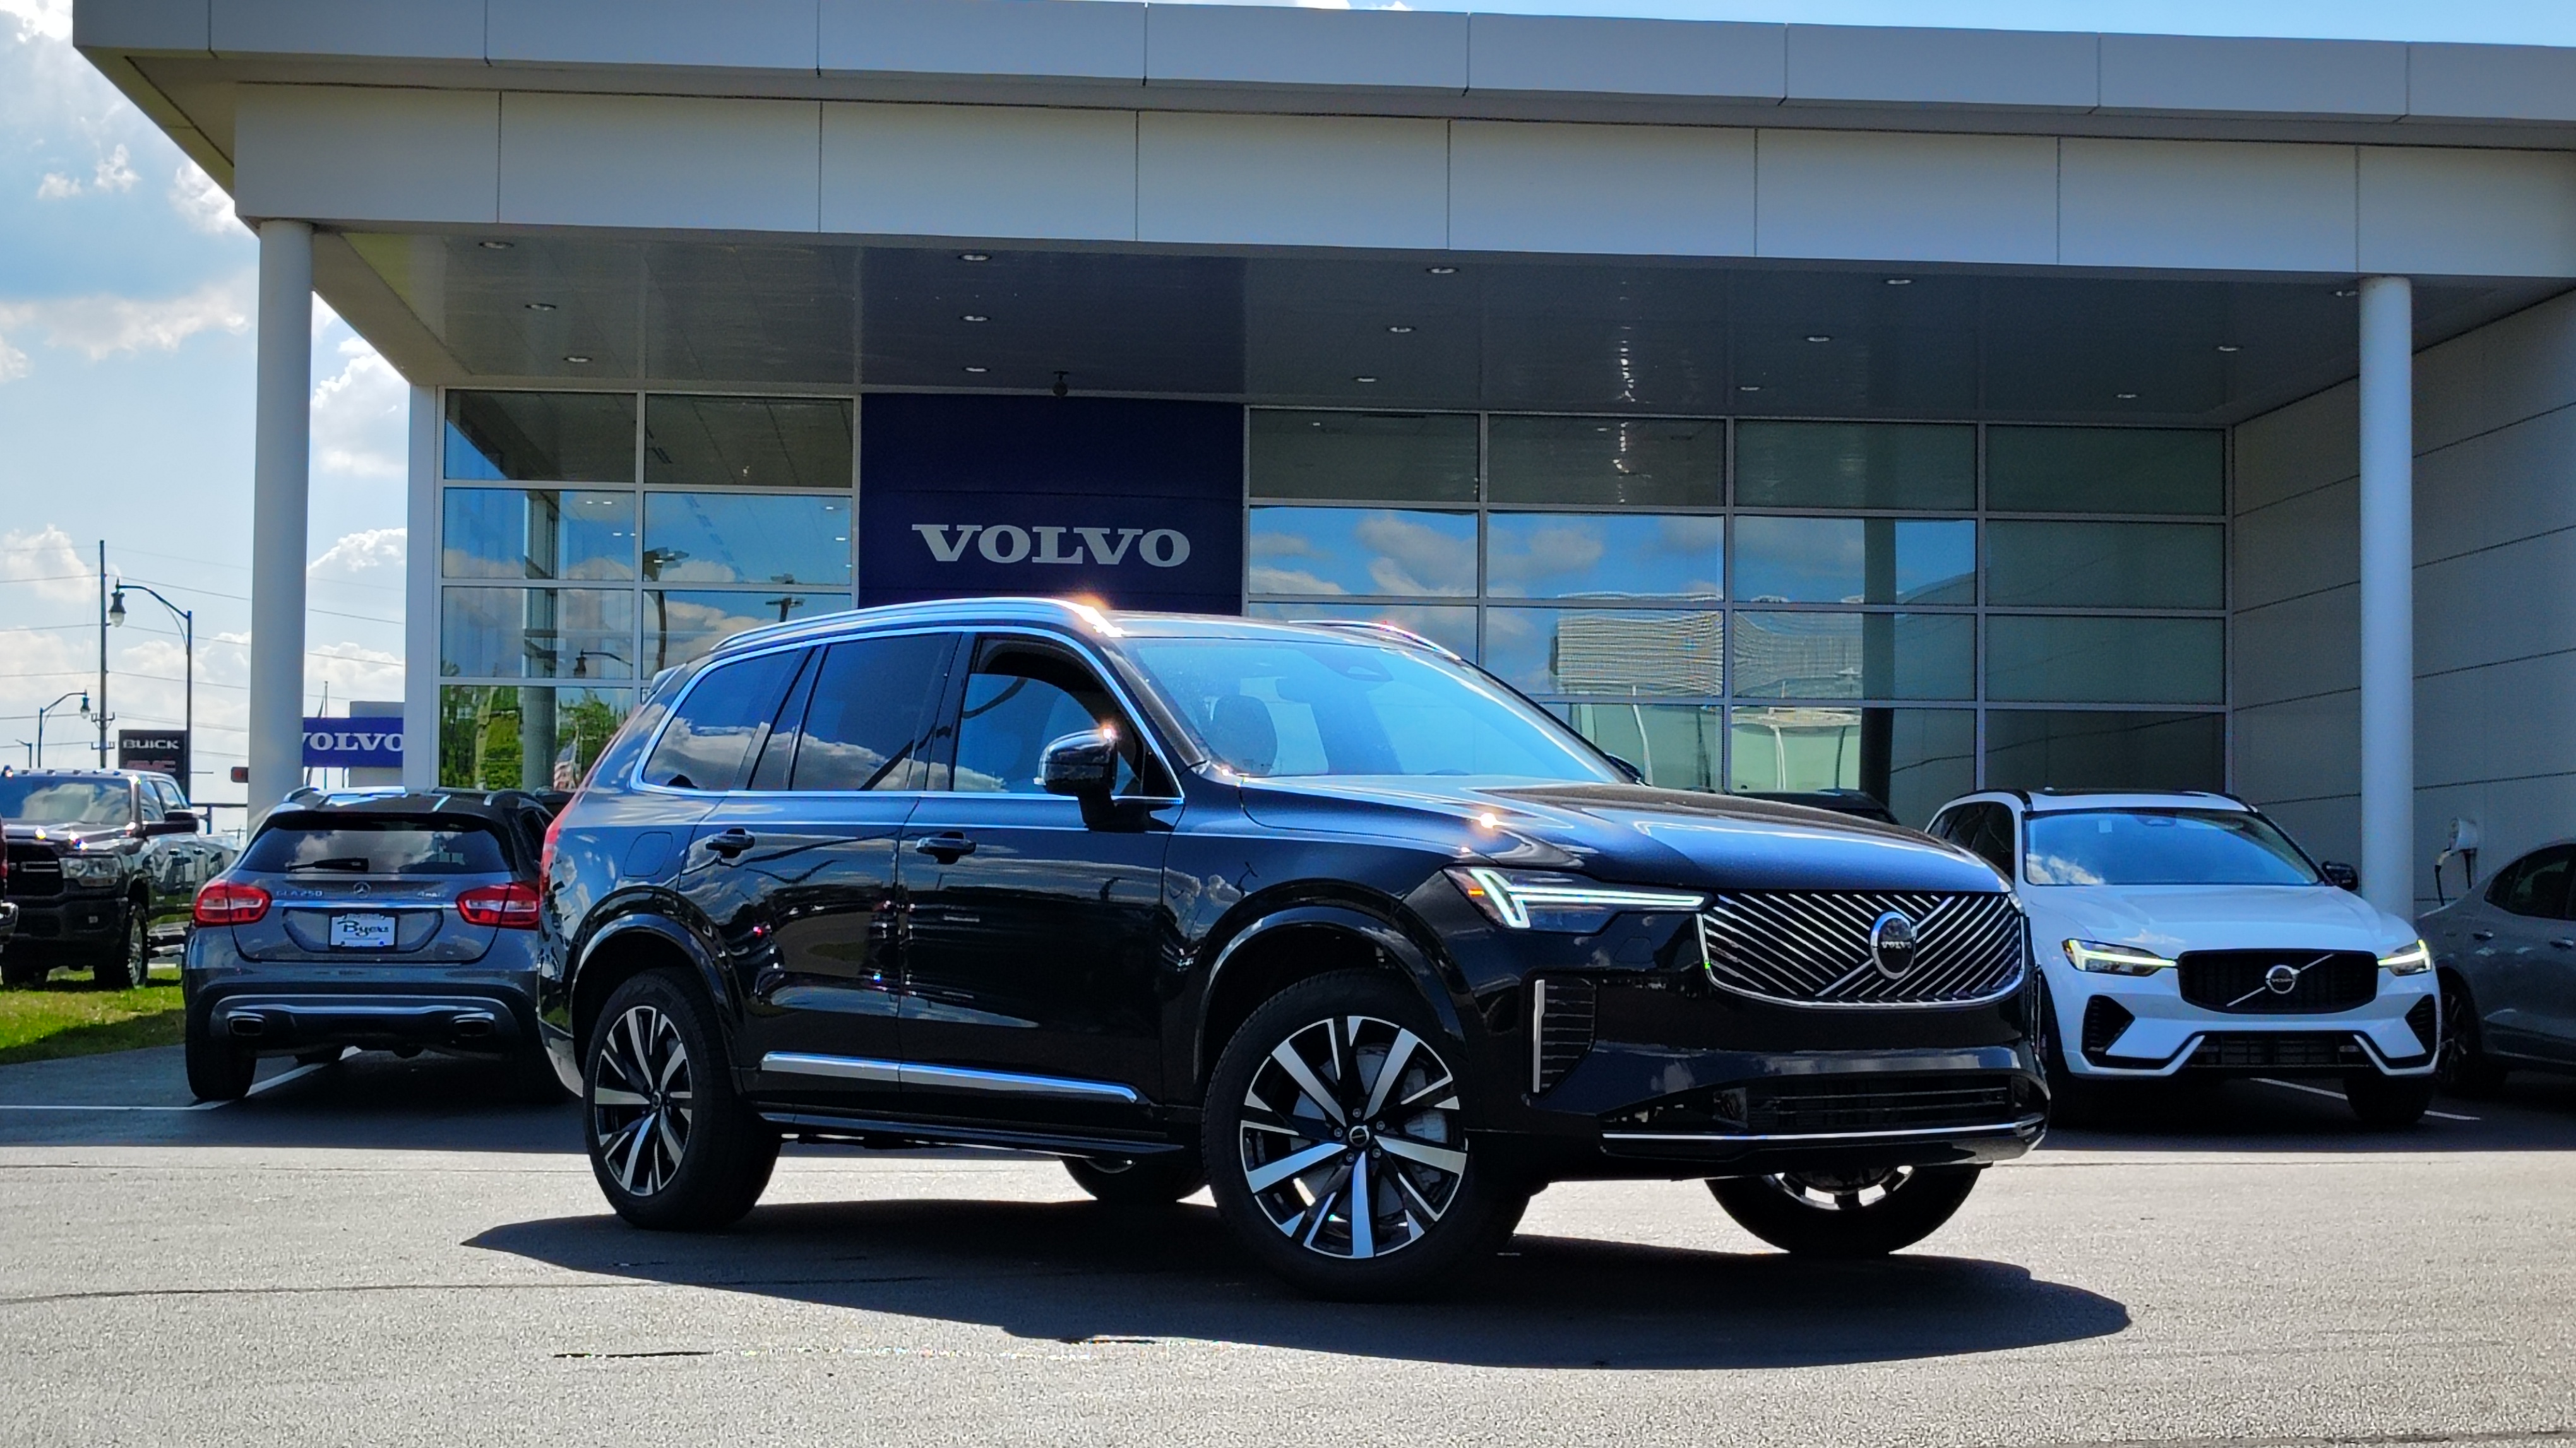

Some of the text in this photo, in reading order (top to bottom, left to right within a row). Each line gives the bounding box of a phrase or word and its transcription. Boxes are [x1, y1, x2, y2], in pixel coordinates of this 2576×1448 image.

[912, 524, 1191, 567] VOLVO
[123, 739, 179, 749] BUICK
[303, 732, 403, 752] OLVO
